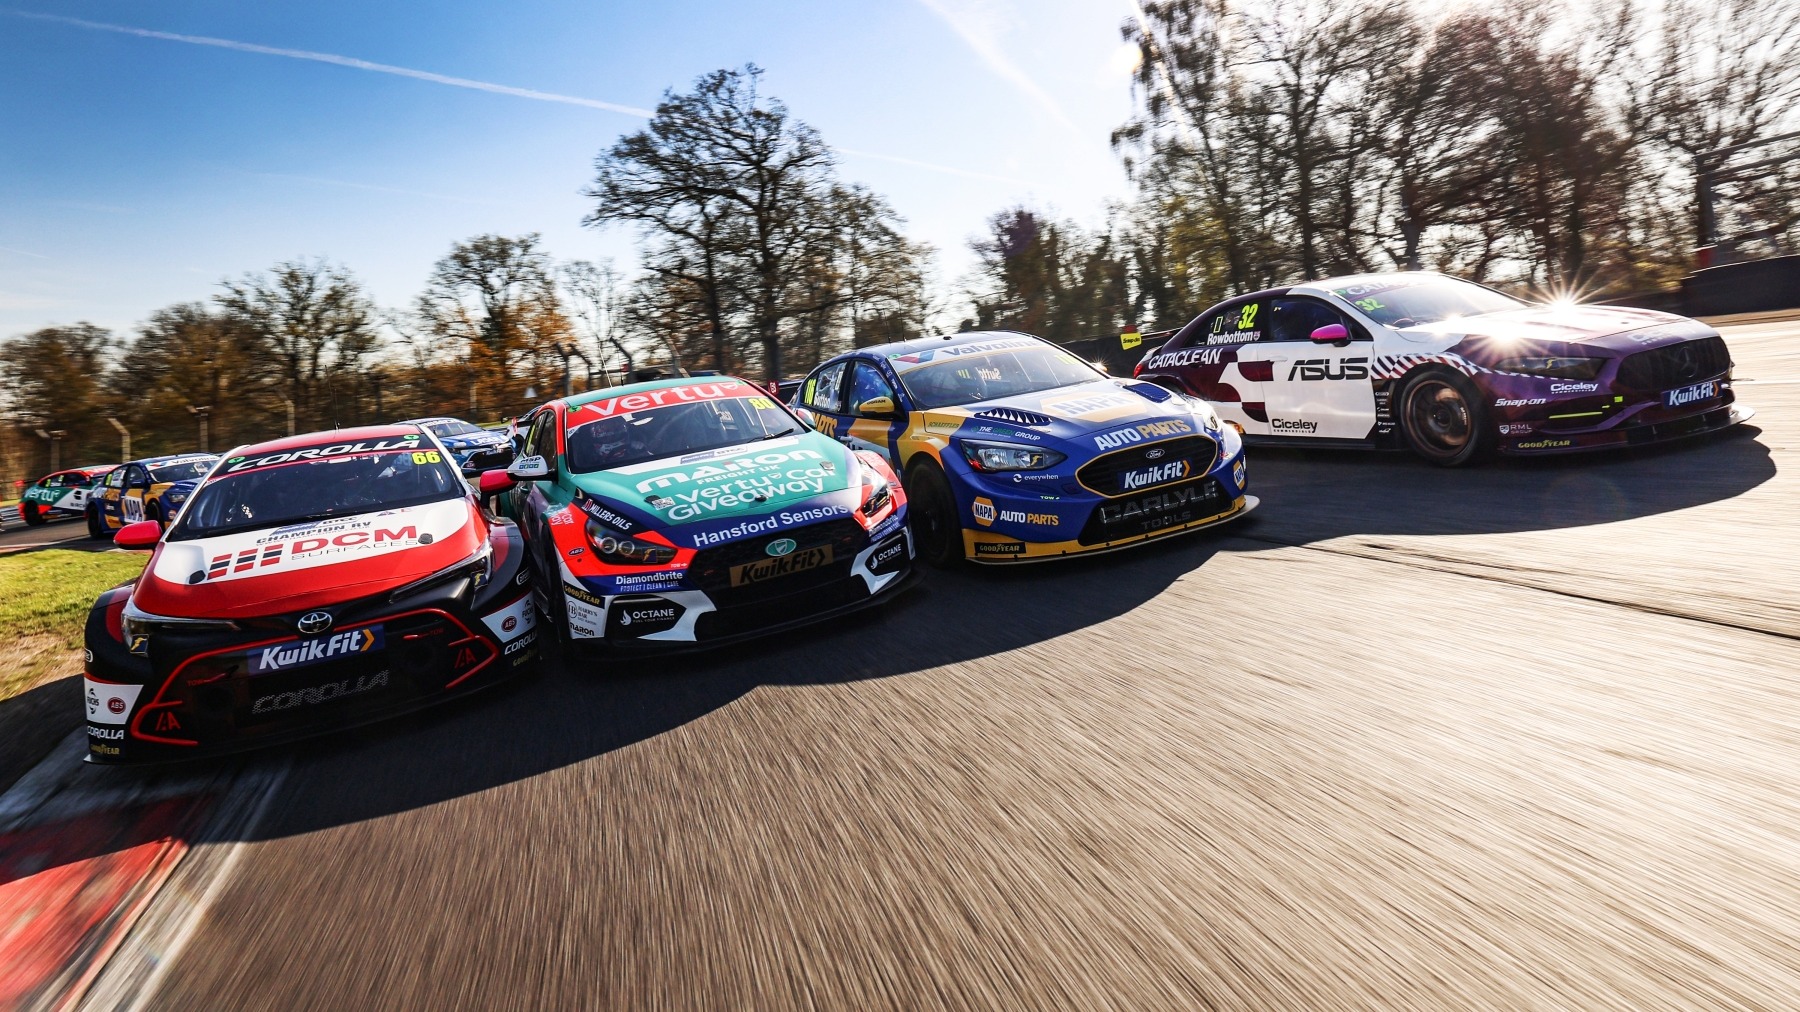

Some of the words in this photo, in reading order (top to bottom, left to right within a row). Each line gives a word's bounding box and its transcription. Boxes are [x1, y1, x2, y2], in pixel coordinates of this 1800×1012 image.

[1354, 298, 1386, 311] 32
[1237, 303, 1259, 330] 32
[1207, 331, 1254, 345] Rowbottom
[1148, 347, 1223, 370] CATACLEAN
[1287, 357, 1369, 381] ASUS
[1550, 381, 1599, 392] Ciceley
[1495, 398, 1547, 408] Snap-on
[1094, 427, 1142, 451] AUTO
[1137, 419, 1191, 439] PARTS
[1271, 418, 1318, 434] Ciceley
[1015, 431, 1041, 441] GROUP
[1518, 439, 1571, 449] GOODYEAR
[227, 439, 421, 472] COROLLA
[411, 450, 441, 465] 66
[696, 468, 757, 486] FREIGHT
[763, 464, 782, 473] UK
[1024, 473, 1059, 482] everywhen
[974, 502, 994, 521] NAPA
[1100, 480, 1219, 524] CARLYLE
[589, 502, 616, 522] MILLERS
[611, 516, 633, 530] OILS
[693, 518, 778, 547] Hansford
[780, 503, 850, 526] Sensors
[1000, 510, 1026, 523] AUTO
[1027, 513, 1059, 526] PARTS
[1140, 510, 1192, 531] TOOLS
[256, 523, 345, 545] CHAMPION
[347, 521, 372, 531] RV
[291, 525, 417, 555] DCM
[291, 539, 418, 561] SURFACES
[878, 543, 901, 561] OCTANE
[980, 543, 1020, 553] GOODYEAR
[615, 571, 683, 585] Diamondbrite
[564, 584, 600, 605] GOODYEAR
[620, 584, 642, 592] PROTECT
[633, 608, 675, 619] OCTANE
[252, 669, 390, 714] COROLLA
